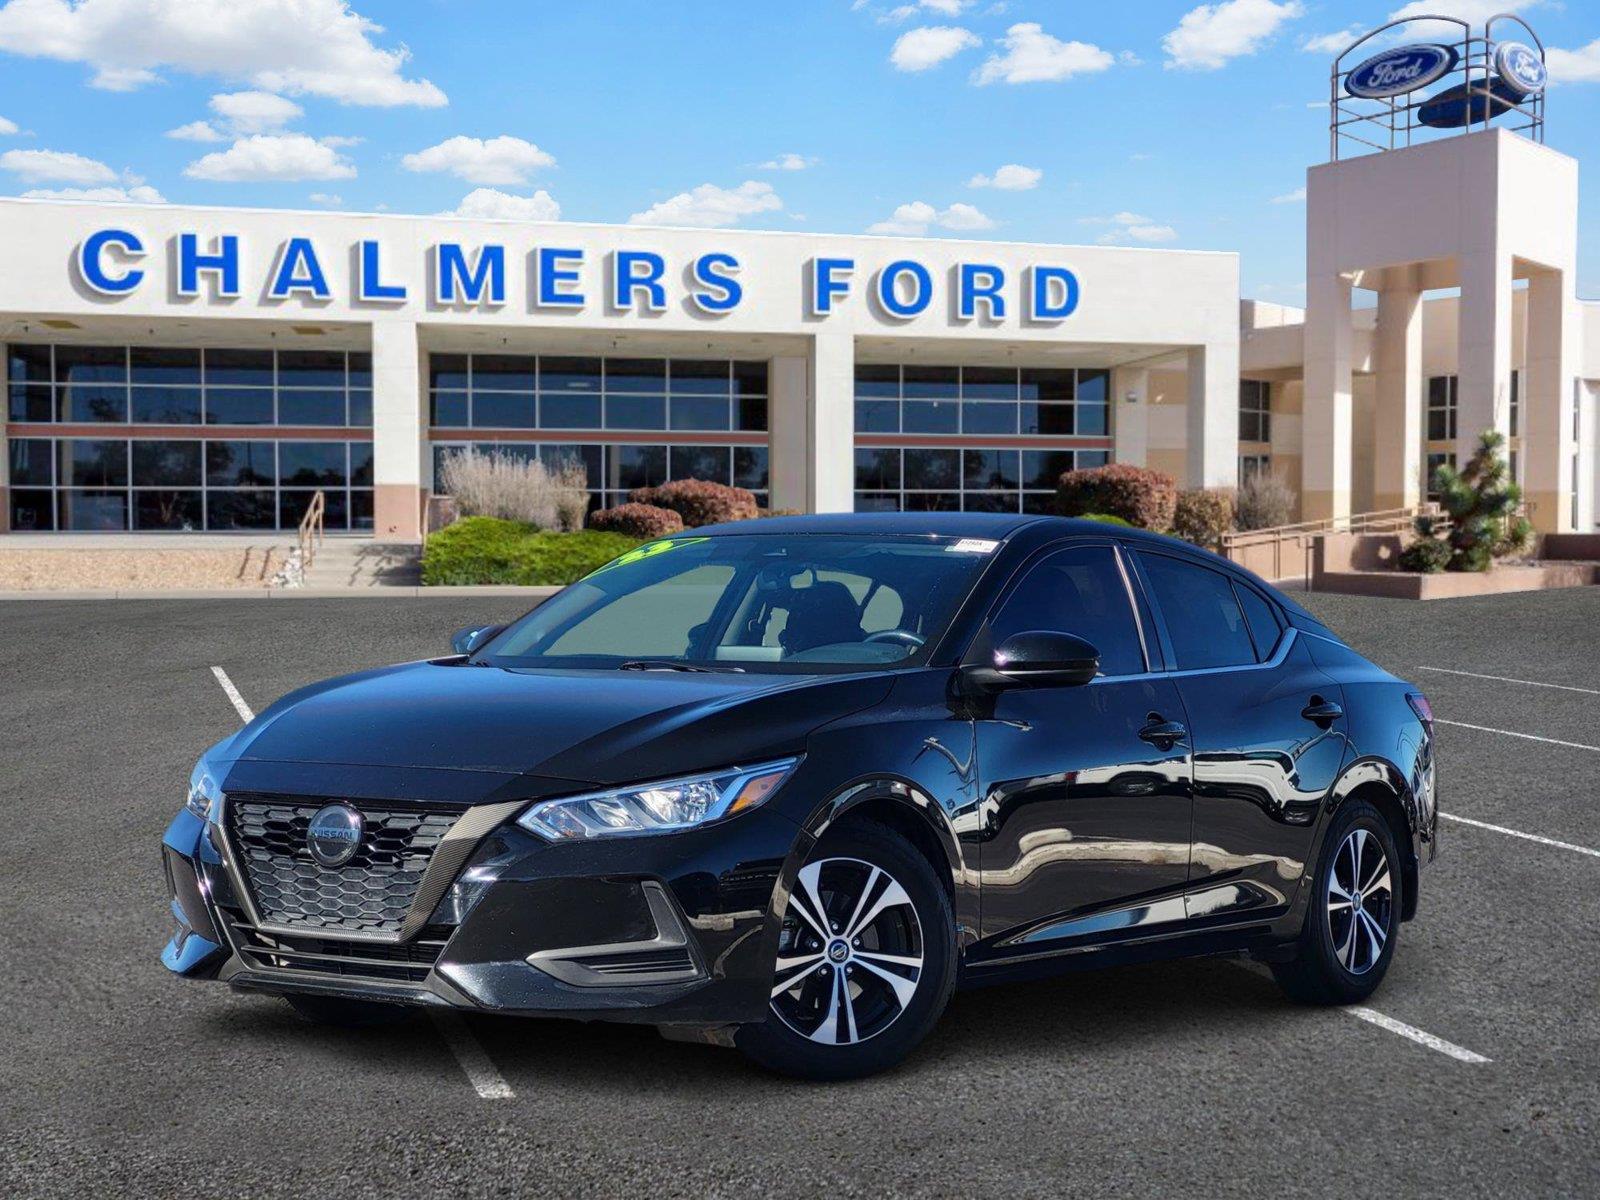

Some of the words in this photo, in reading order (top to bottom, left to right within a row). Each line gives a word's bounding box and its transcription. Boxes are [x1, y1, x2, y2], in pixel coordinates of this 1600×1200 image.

[1368, 56, 1423, 87] Ford
[80, 228, 745, 312] CHALMERS
[815, 257, 1081, 322] FORD
[311, 828, 353, 840] NISSAN
